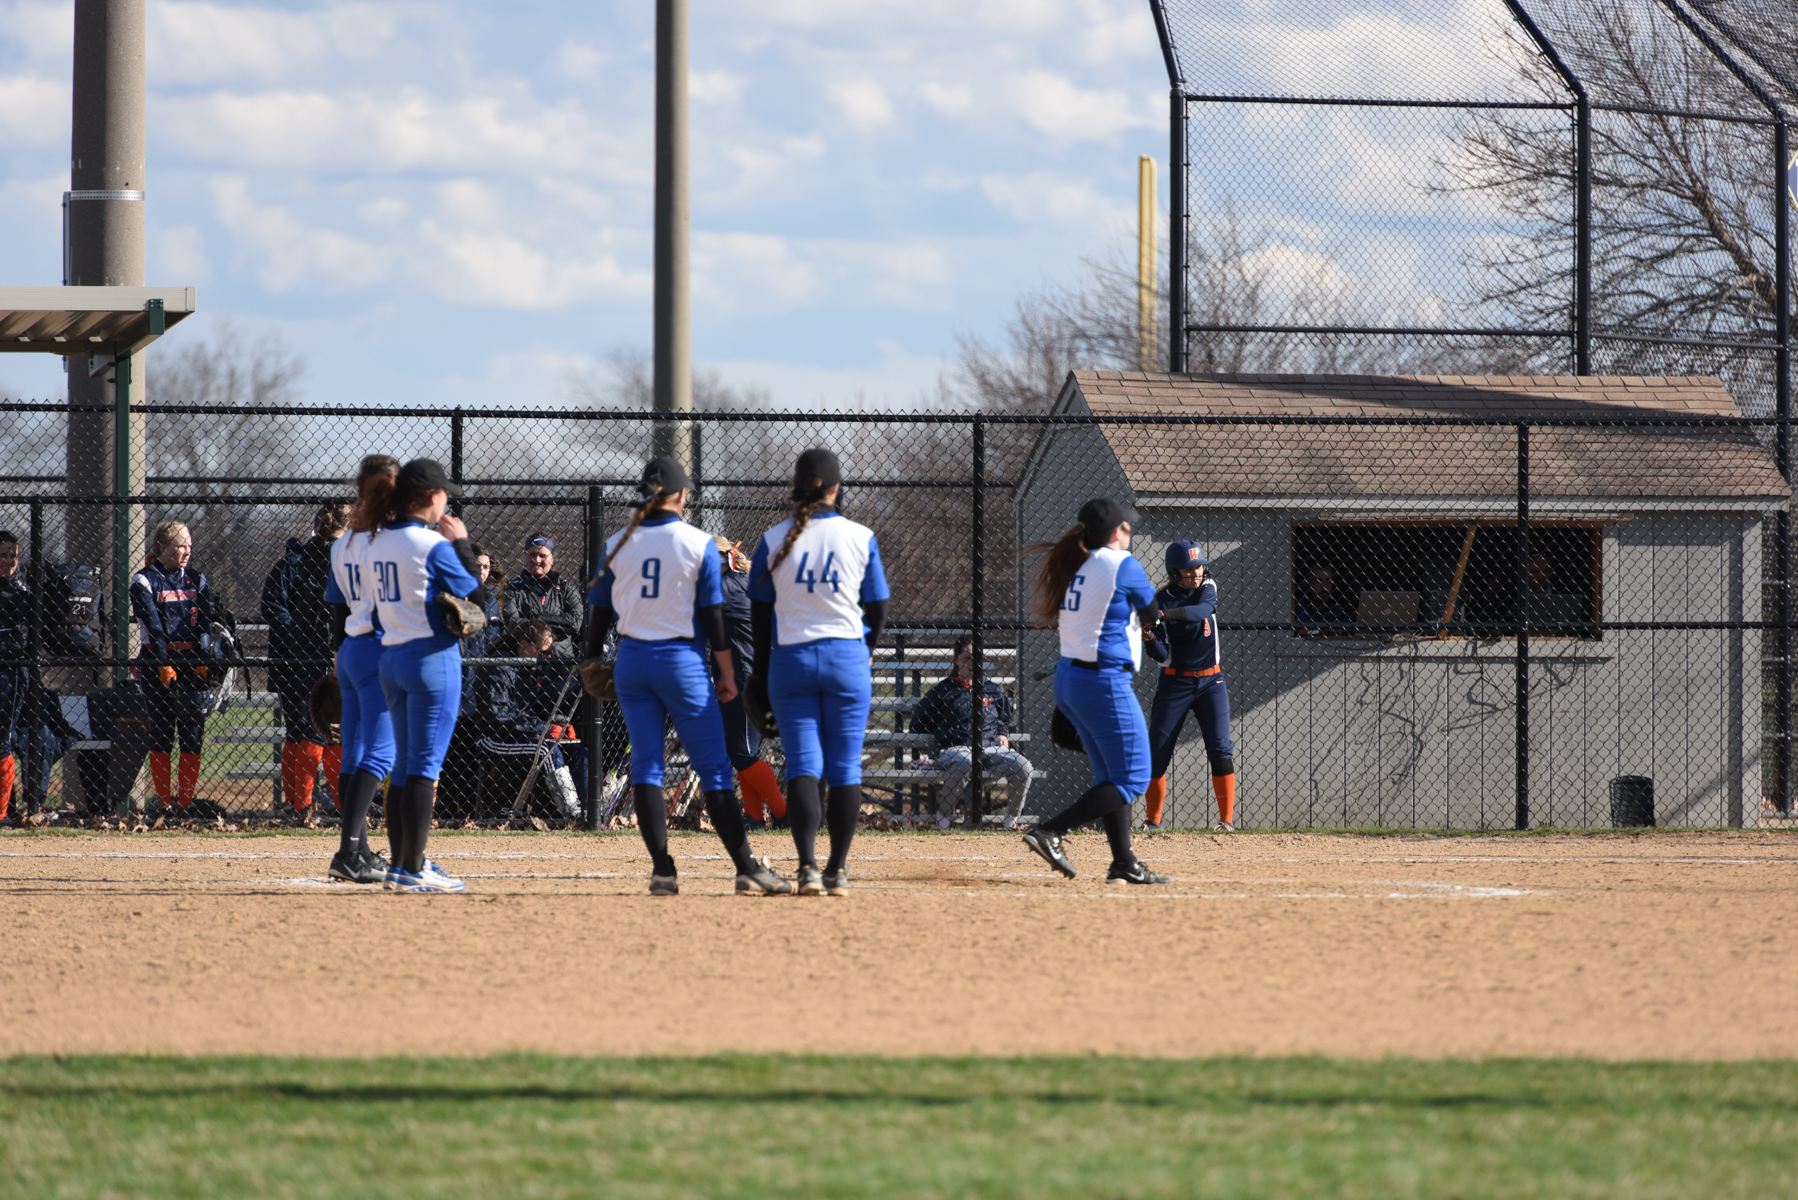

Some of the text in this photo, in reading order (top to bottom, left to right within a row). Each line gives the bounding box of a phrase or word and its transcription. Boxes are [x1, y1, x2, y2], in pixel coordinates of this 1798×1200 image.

[795, 551, 840, 593] 44
[1188, 547, 1199, 560] W
[374, 561, 401, 602] 30
[641, 557, 661, 599] 9
[72, 603, 86, 615] 21
